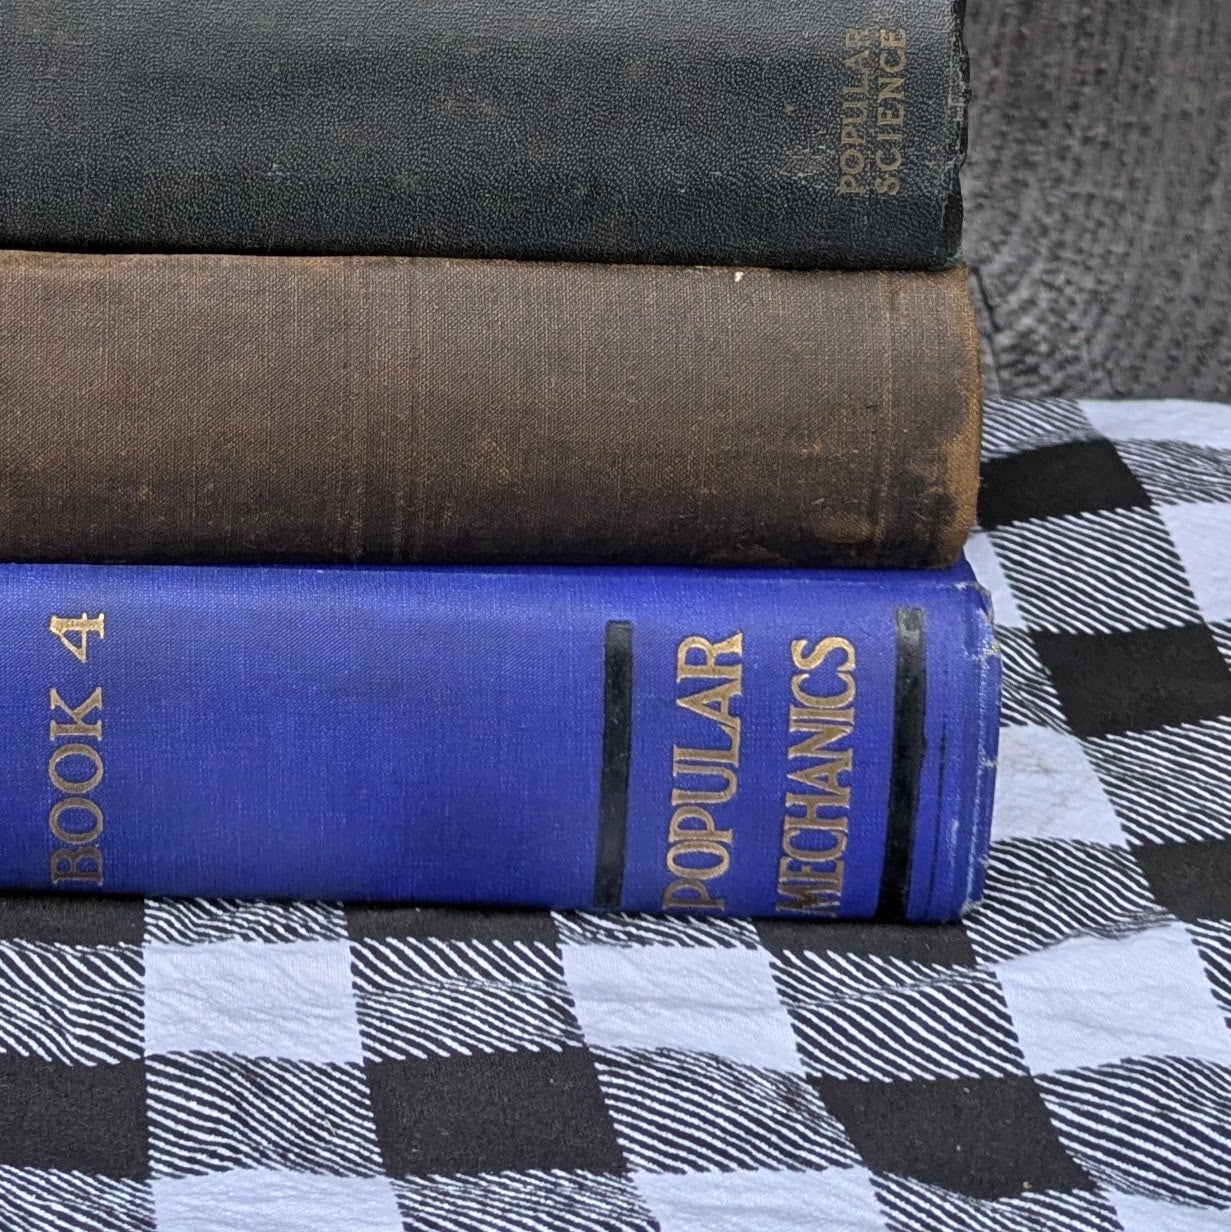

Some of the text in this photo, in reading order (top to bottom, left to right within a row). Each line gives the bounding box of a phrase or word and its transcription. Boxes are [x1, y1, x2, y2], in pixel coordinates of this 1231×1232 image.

[835, 27, 870, 195] POPULAR
[875, 28, 908, 195] SCIENCE
[48, 612, 105, 886] BOOK 4
[662, 631, 743, 911] POPULAR
[775, 636, 856, 918] MECHANICS
